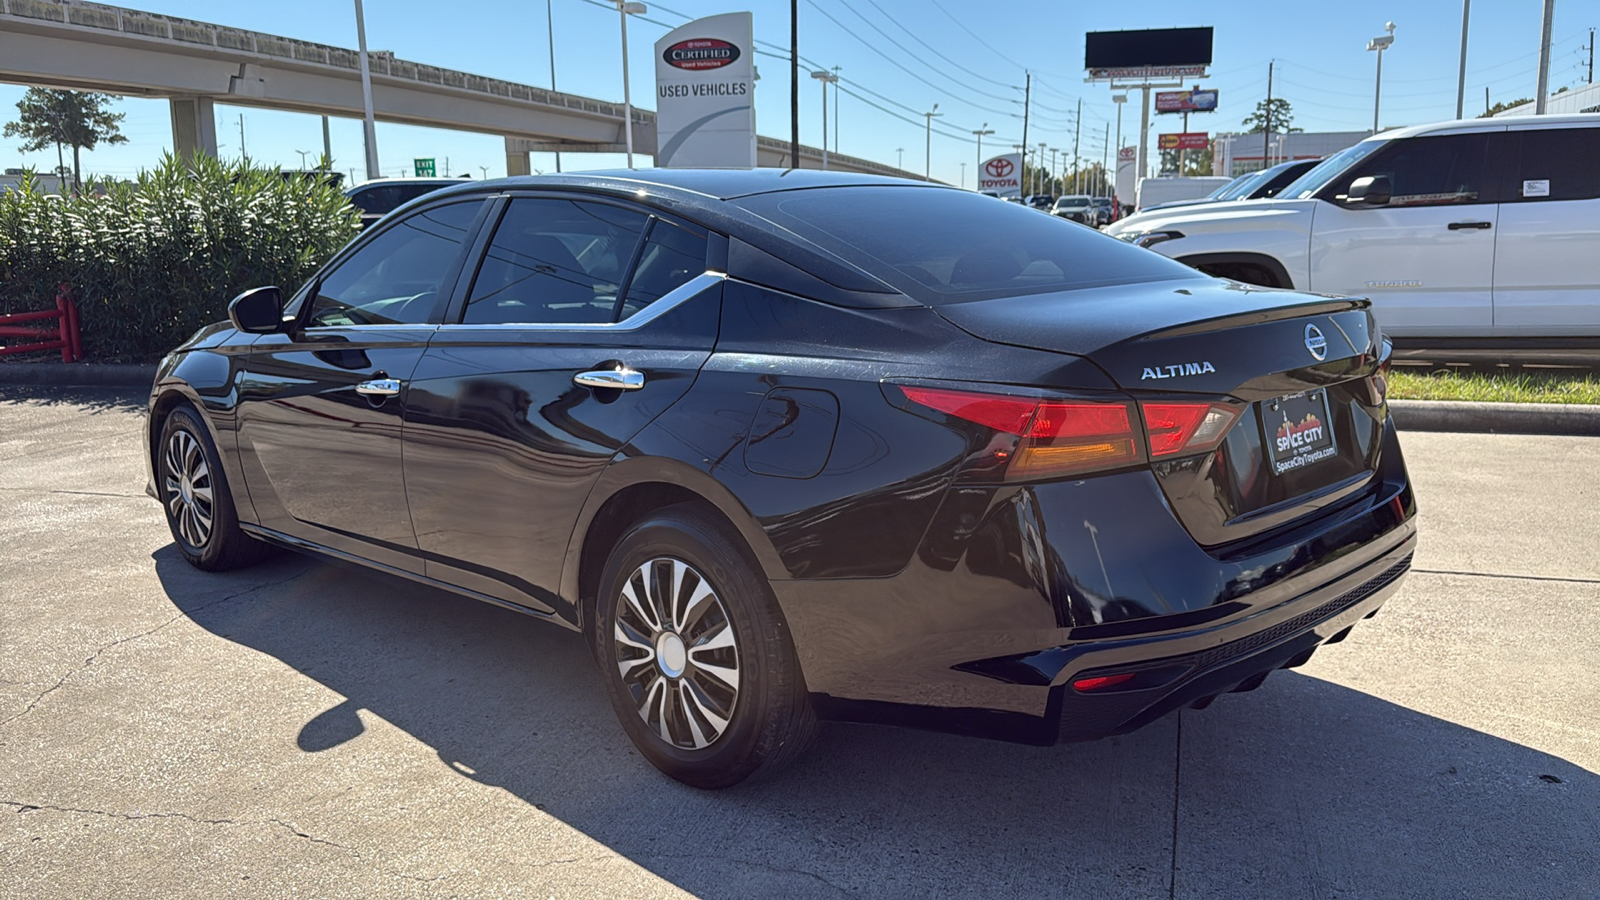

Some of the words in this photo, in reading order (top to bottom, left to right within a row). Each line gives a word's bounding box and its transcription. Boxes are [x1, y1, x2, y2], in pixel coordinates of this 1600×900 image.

[672, 49, 730, 60] CERTIFIED
[660, 84, 689, 98] USED
[692, 82, 746, 97] VEHICLES
[417, 161, 433, 169] EXIT
[981, 179, 1018, 187] TOYOTA
[1141, 361, 1216, 380] ALTIMA
[1277, 431, 1304, 452] SPACE
[1303, 426, 1323, 444] CITY
[1276, 447, 1335, 472] SpaceCityToyota.com
